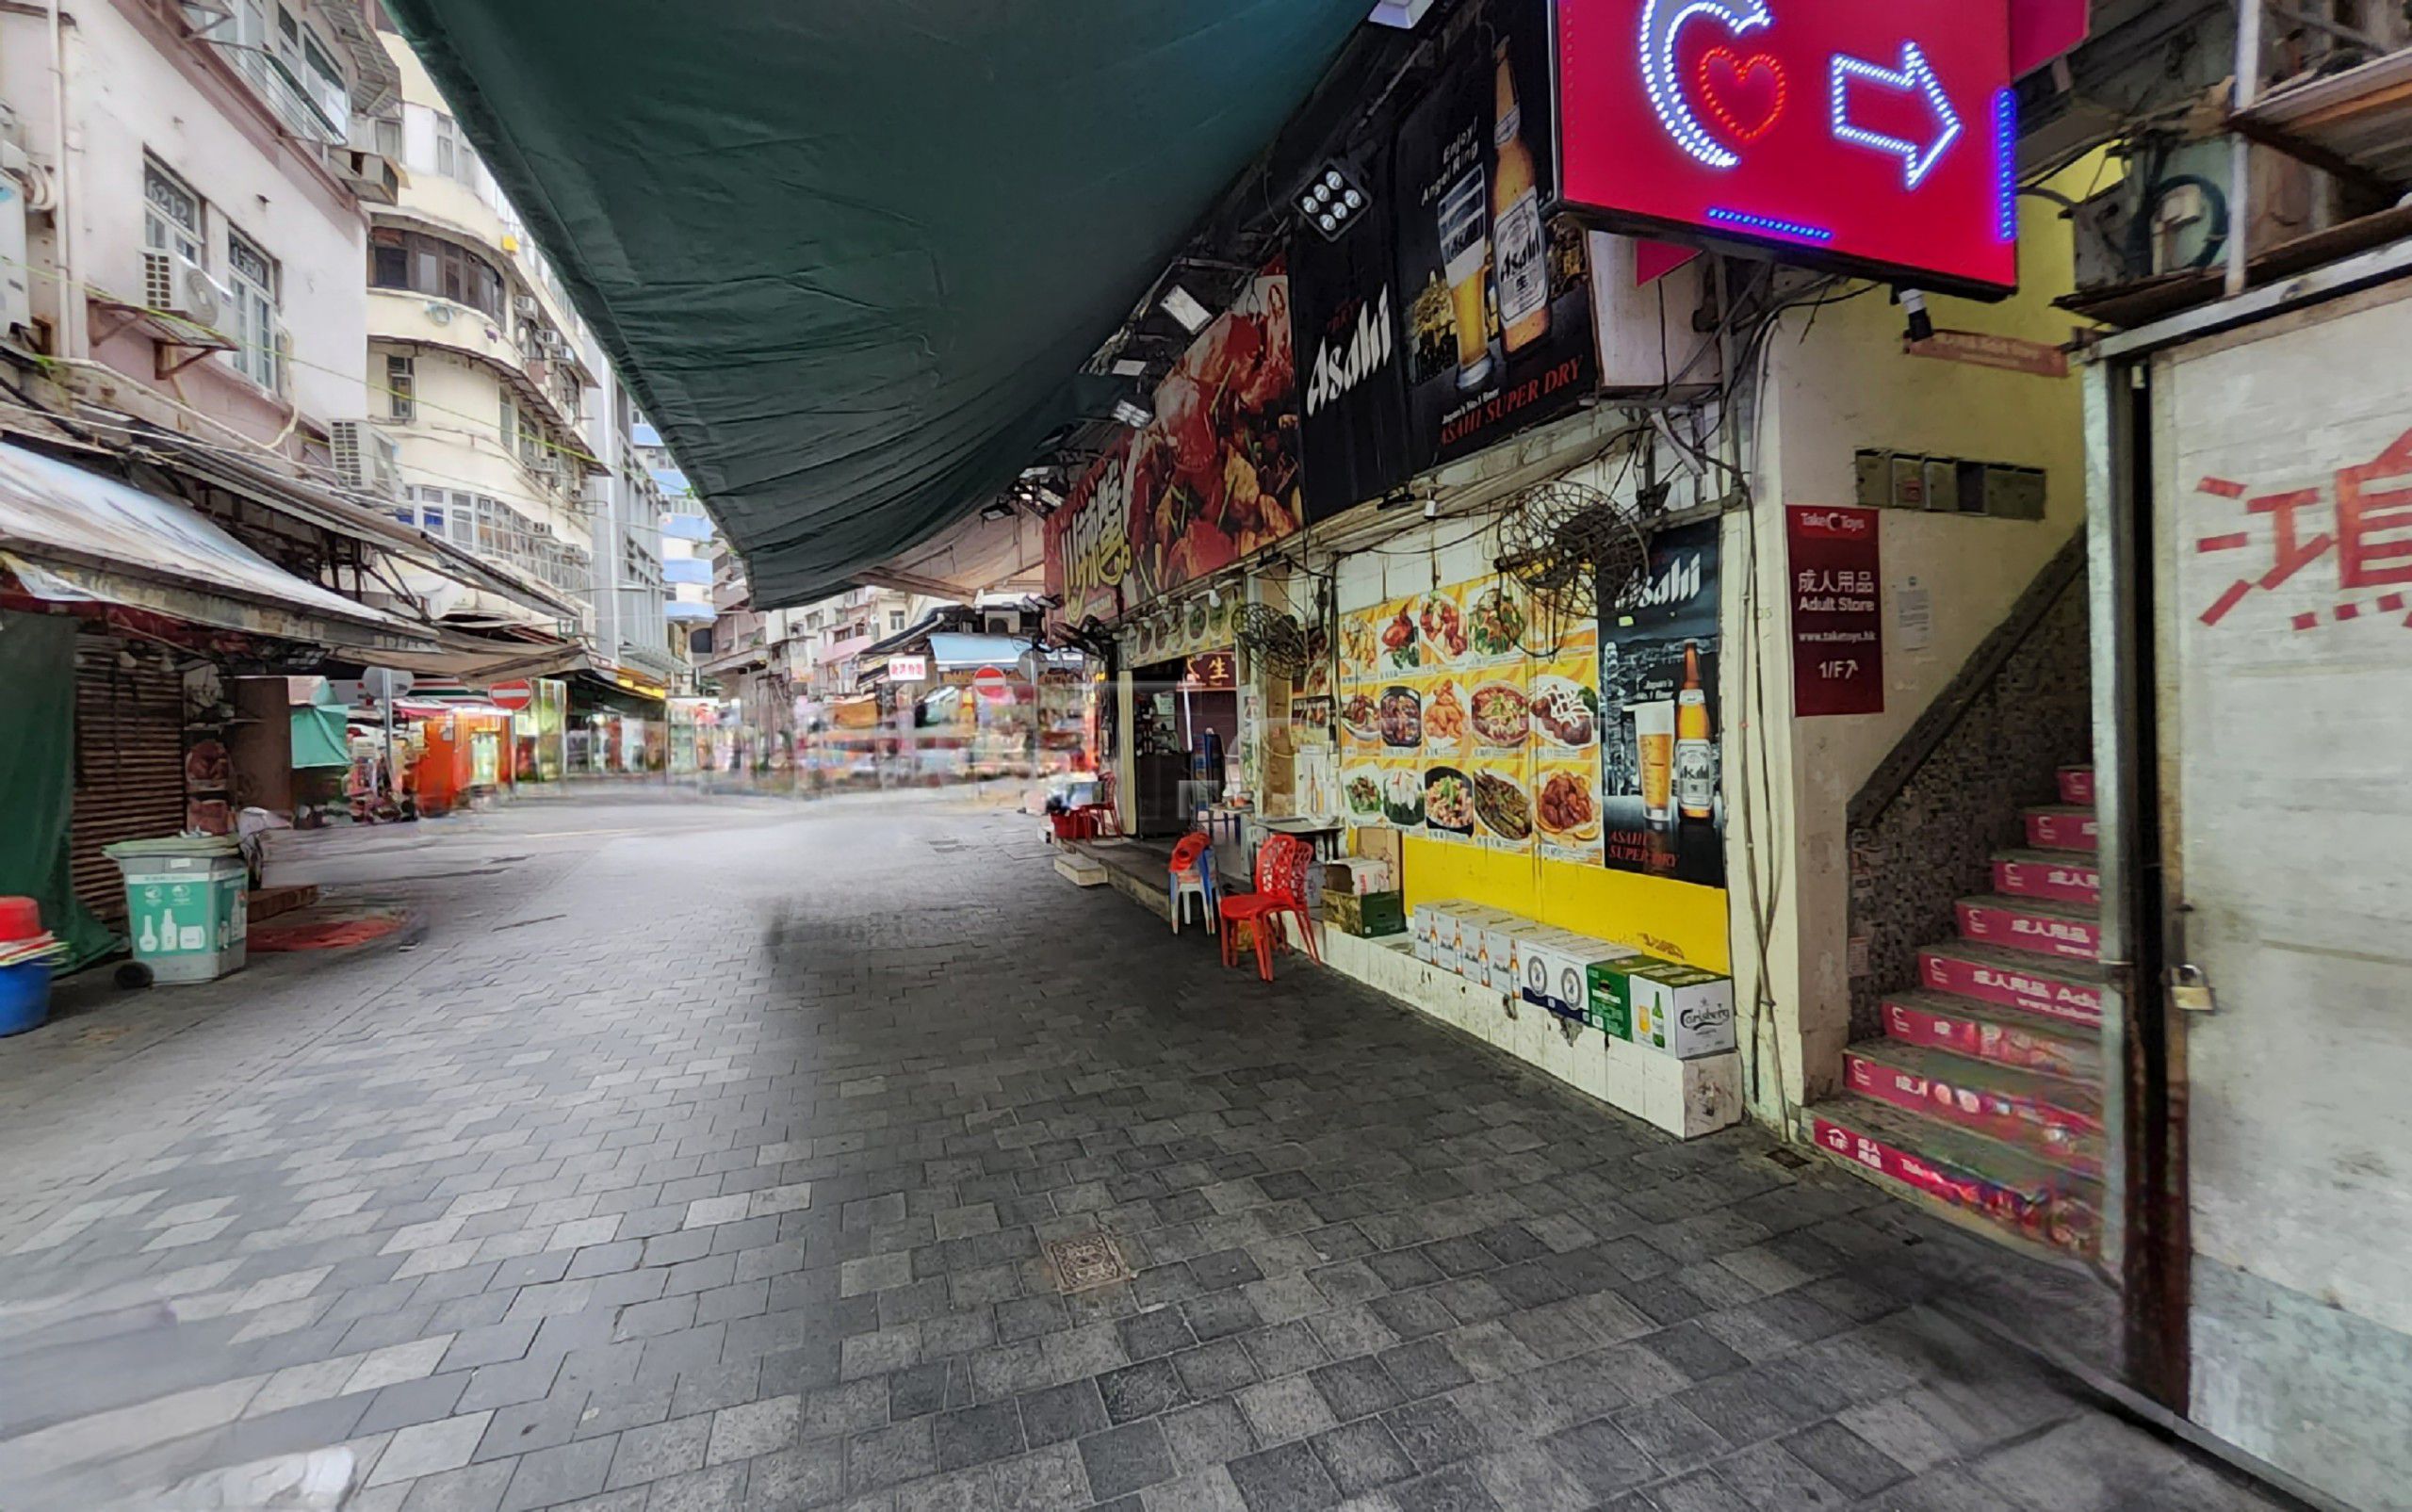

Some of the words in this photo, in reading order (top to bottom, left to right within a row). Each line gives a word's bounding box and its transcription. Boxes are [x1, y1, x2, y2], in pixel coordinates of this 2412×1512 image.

[147, 179, 188, 225] 6212
[1307, 285, 1392, 416] Asahi
[1441, 409, 1482, 446] ASAHI
[1486, 379, 1539, 423] SUPER
[1543, 354, 1583, 394] DRY
[1840, 515, 1865, 531] Toys
[1615, 552, 1701, 610] Asahi
[1798, 569, 1874, 593] 成人用品
[1799, 596, 1835, 611] Adult
[1838, 596, 1874, 611] Store
[1818, 660, 1844, 678] 1/F
[1609, 829, 1648, 846] ASAHI
[1609, 845, 1649, 862] SUPER
